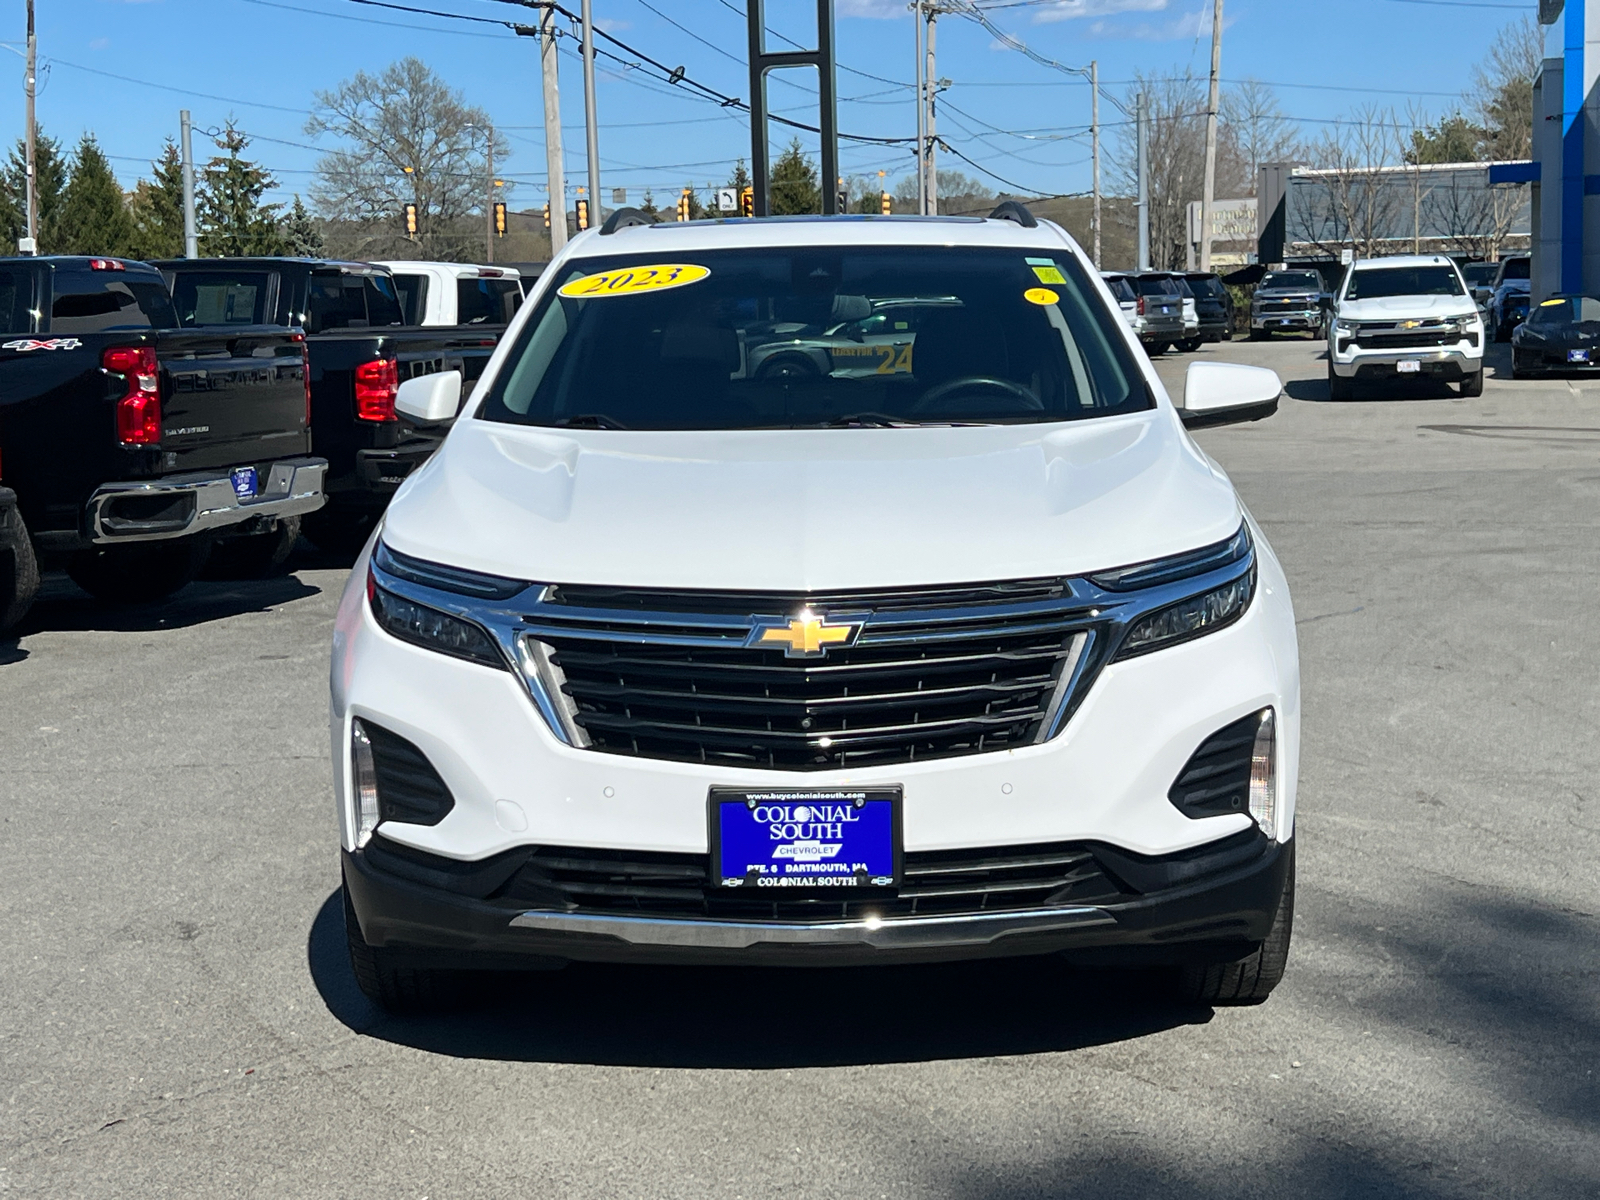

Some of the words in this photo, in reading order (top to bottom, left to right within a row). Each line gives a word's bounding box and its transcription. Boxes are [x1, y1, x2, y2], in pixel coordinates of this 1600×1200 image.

[581, 268, 683, 294] 2023
[746, 792, 866, 800] www.buycolonialsouth.com
[753, 805, 860, 823] COLONIAL
[770, 823, 843, 840] SOUTH
[780, 847, 835, 855] CHEVROLET
[785, 863, 850, 873] DARTMOUTH,
[757, 877, 816, 886] COLONIAL
[818, 876, 857, 886] SOUTH
